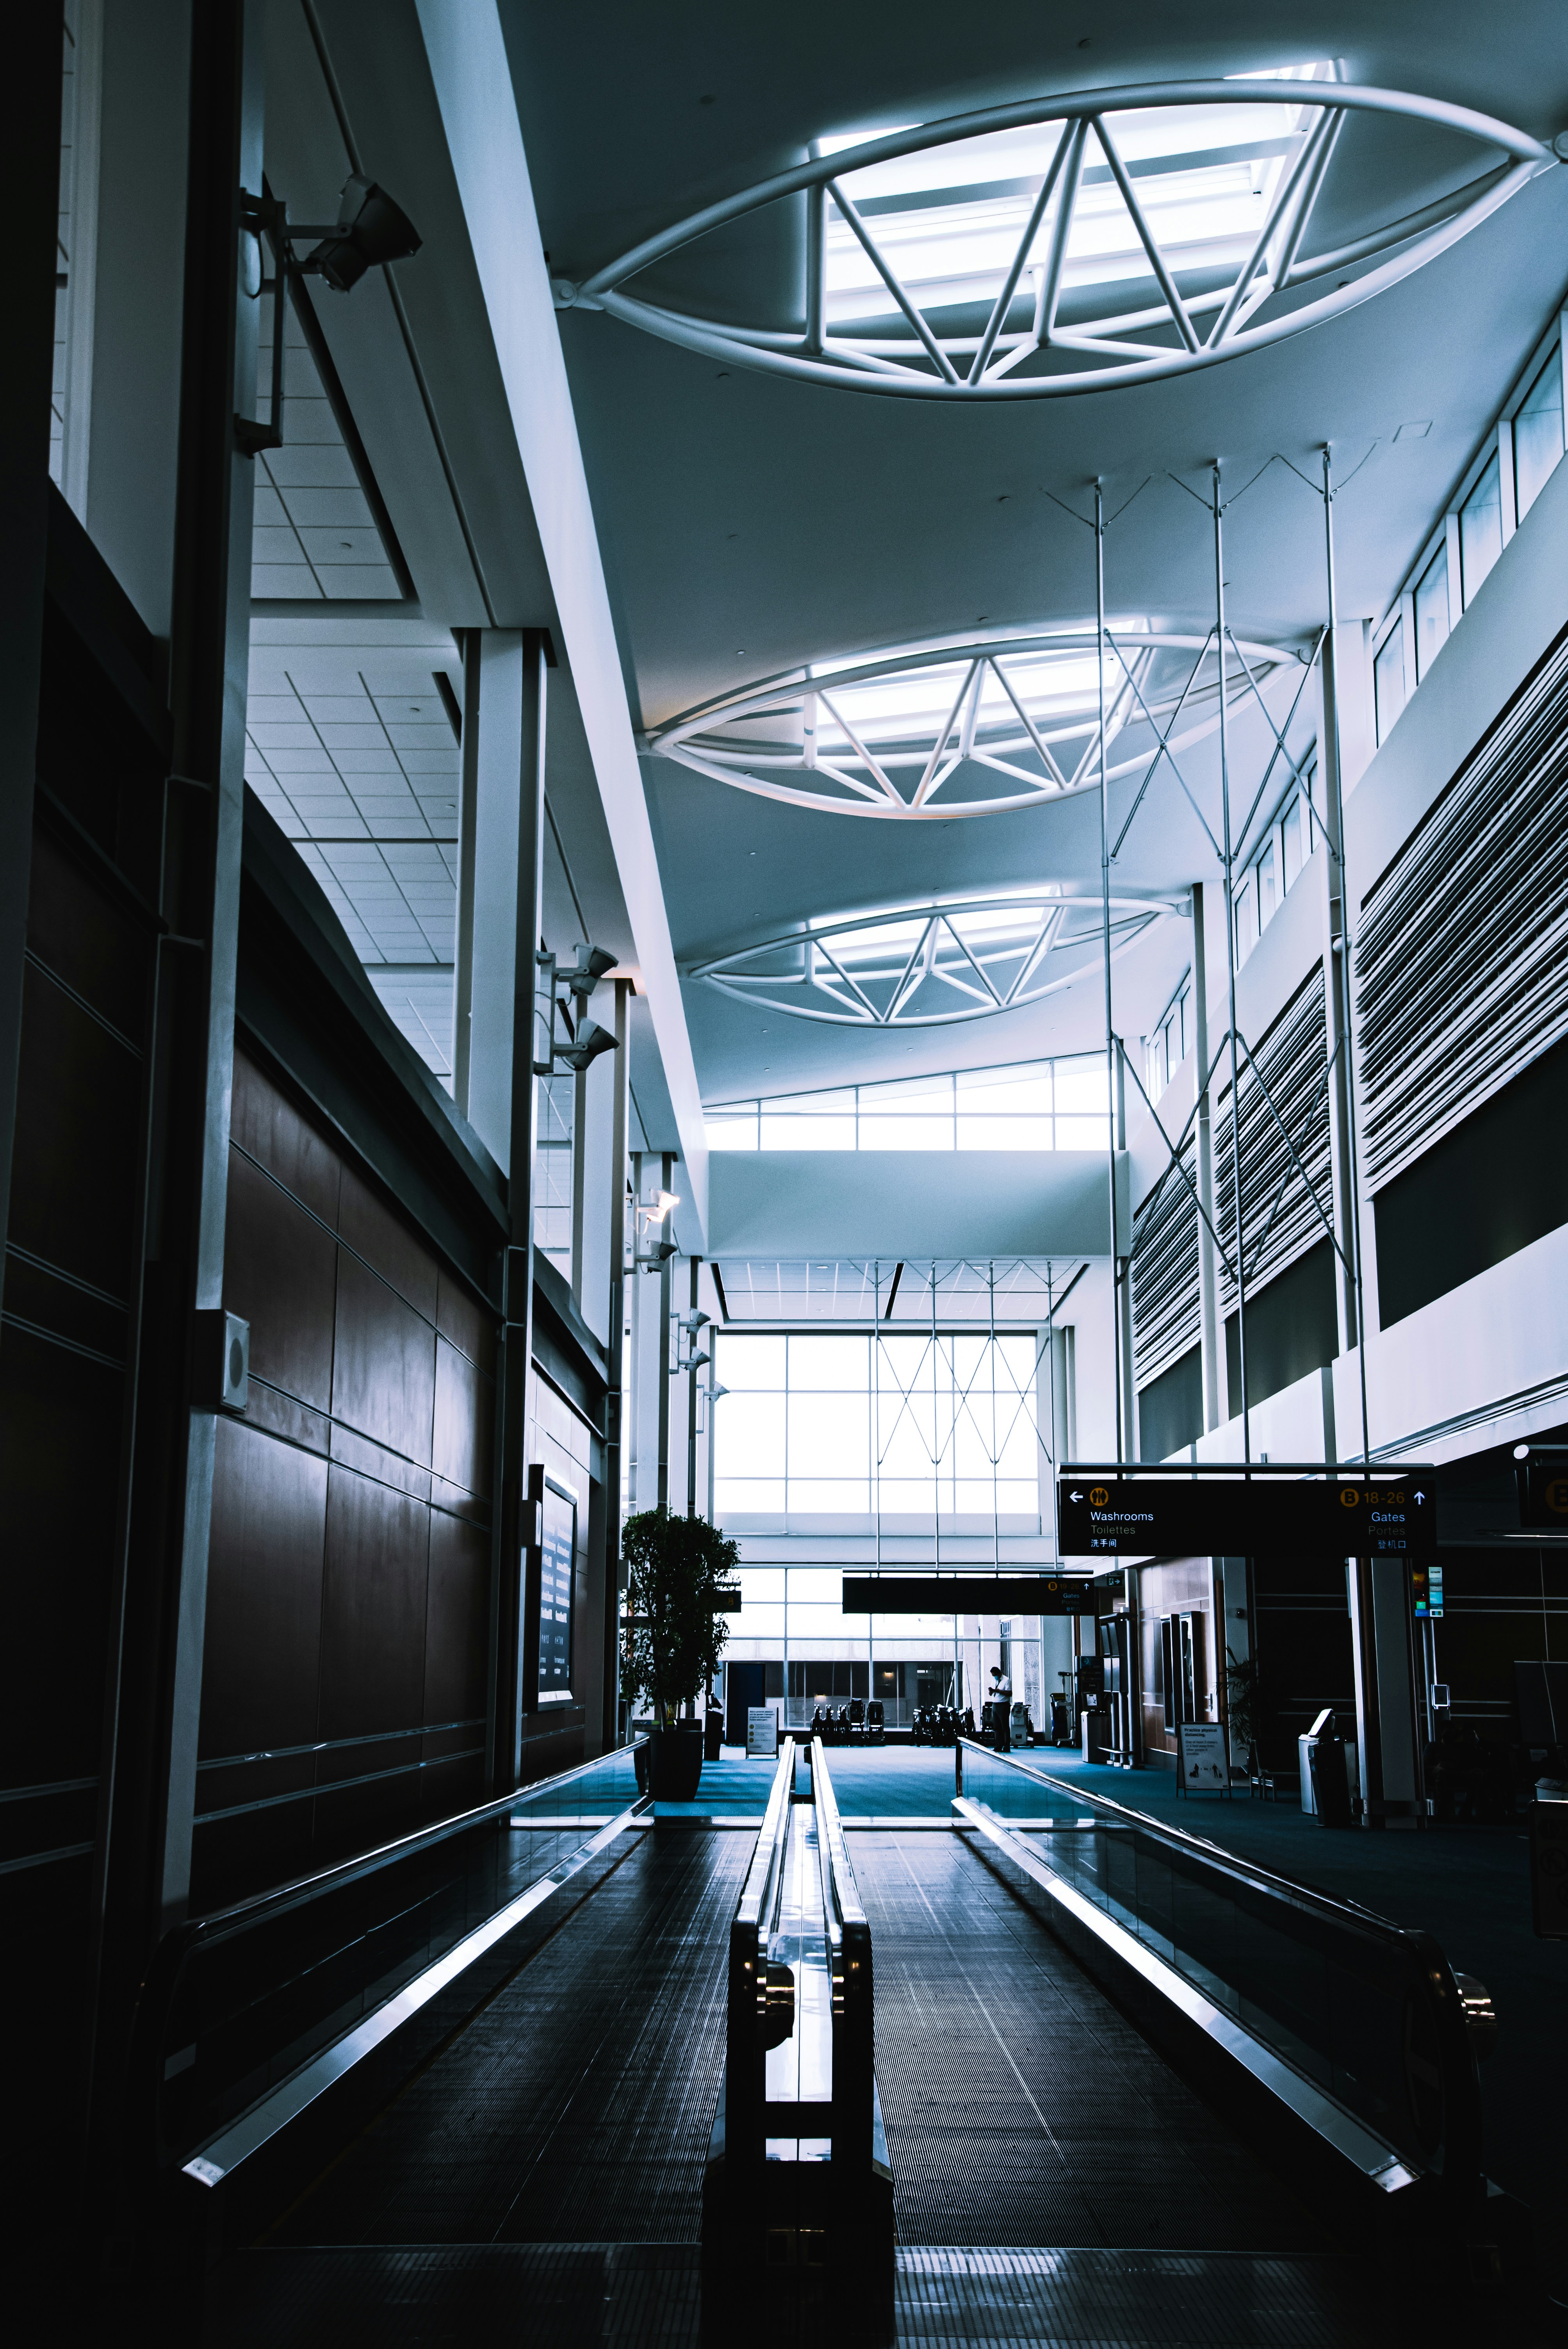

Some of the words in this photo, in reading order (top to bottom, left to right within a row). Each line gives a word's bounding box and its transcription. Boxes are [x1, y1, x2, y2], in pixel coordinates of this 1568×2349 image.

[1363, 1491, 1405, 1504] 18-26
[1090, 1511, 1154, 1521] Washrooms
[1371, 1511, 1405, 1522] Gates
[1090, 1525, 1136, 1534] Toilettes
[1368, 1526, 1405, 1535] Portes
[1091, 1538, 1117, 1547] 洗手间
[1377, 1540, 1406, 1549] 登机口
